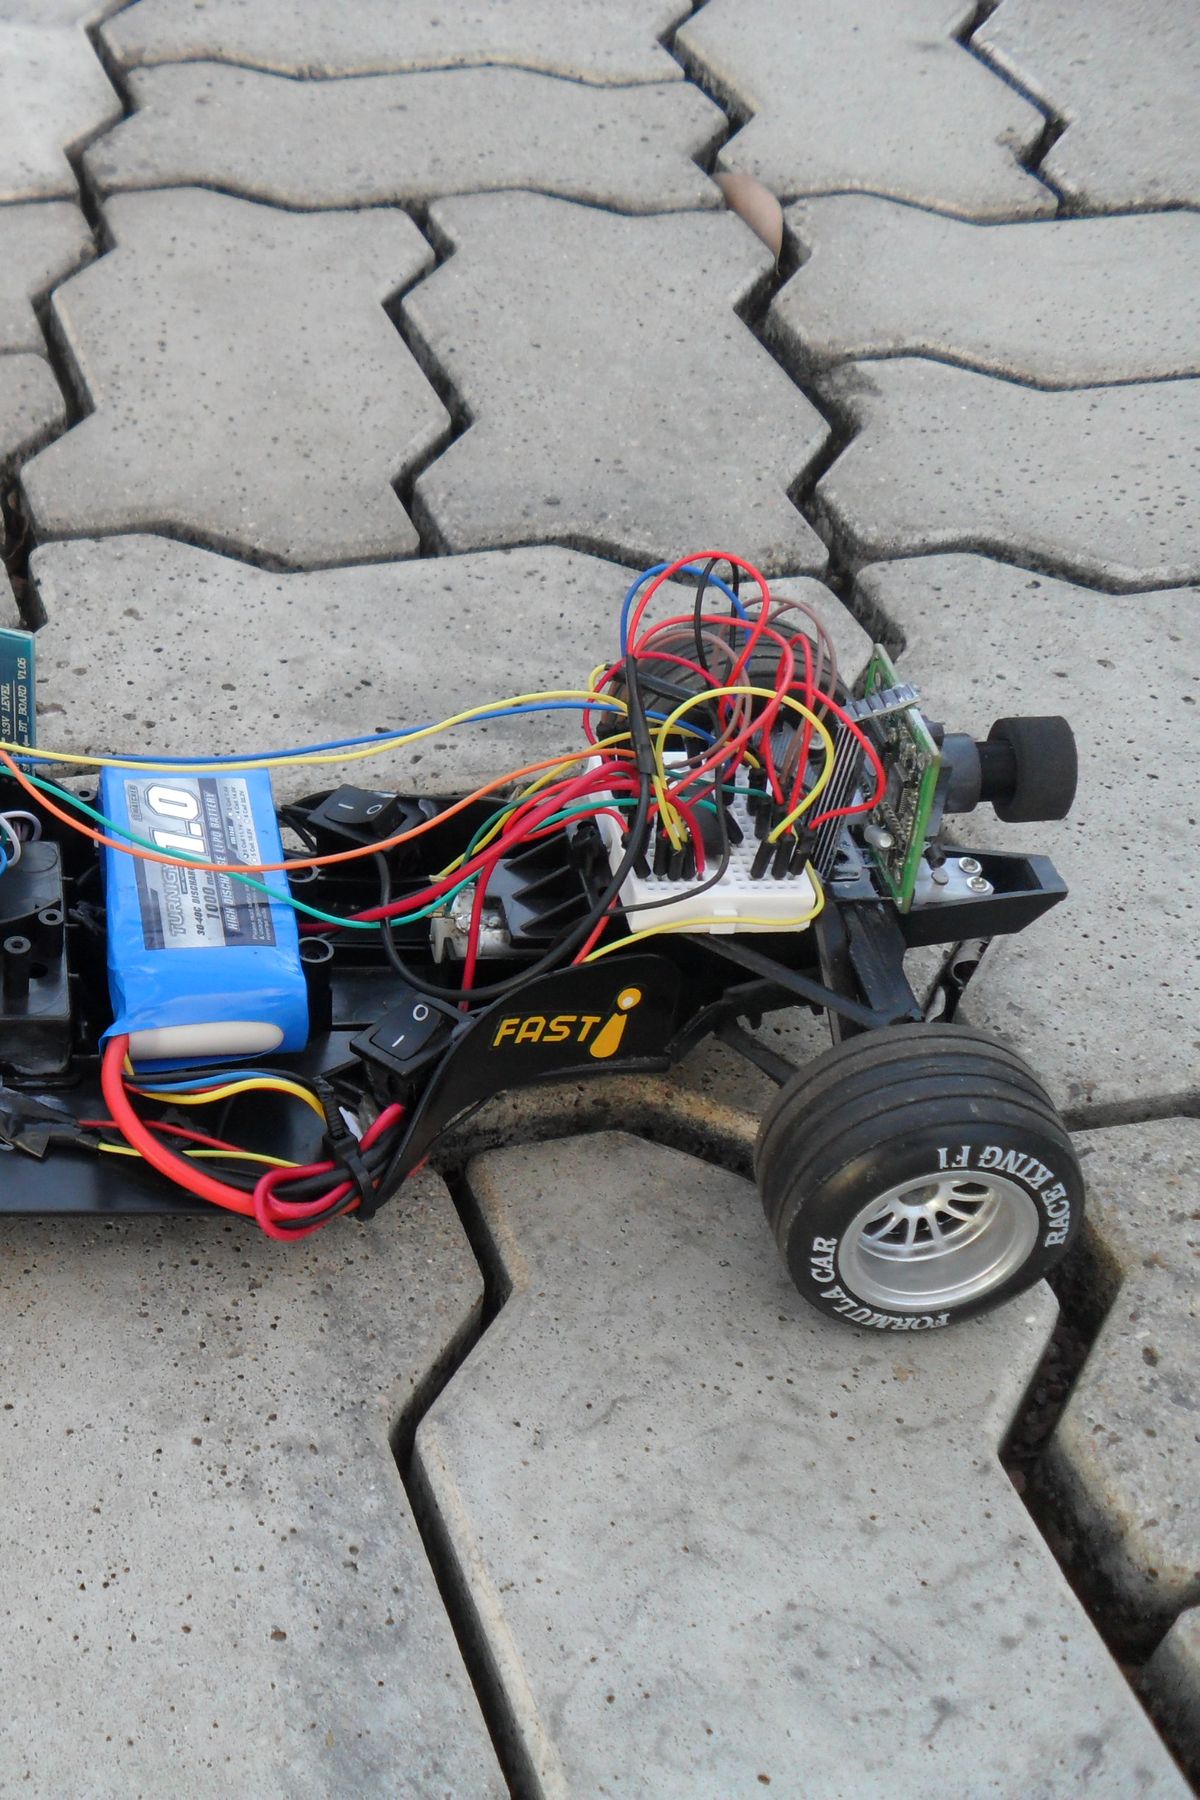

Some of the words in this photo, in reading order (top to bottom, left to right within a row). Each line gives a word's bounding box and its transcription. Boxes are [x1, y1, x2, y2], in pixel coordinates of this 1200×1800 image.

[0, 683, 10, 712] LEVEL
[144, 783, 208, 856] 1.0
[204, 791, 221, 829] BATTERY
[188, 867, 200, 905] DISCHAR
[202, 887, 220, 920] 1000
[223, 906, 238, 931] HIGH
[493, 1015, 602, 1047] FAST
[937, 1145, 971, 1169] F1
[977, 1145, 1057, 1190] KING
[1040, 1182, 1071, 1247] RACE
[810, 1236, 838, 1284] CAR
[819, 1286, 951, 1331] FORMULA
